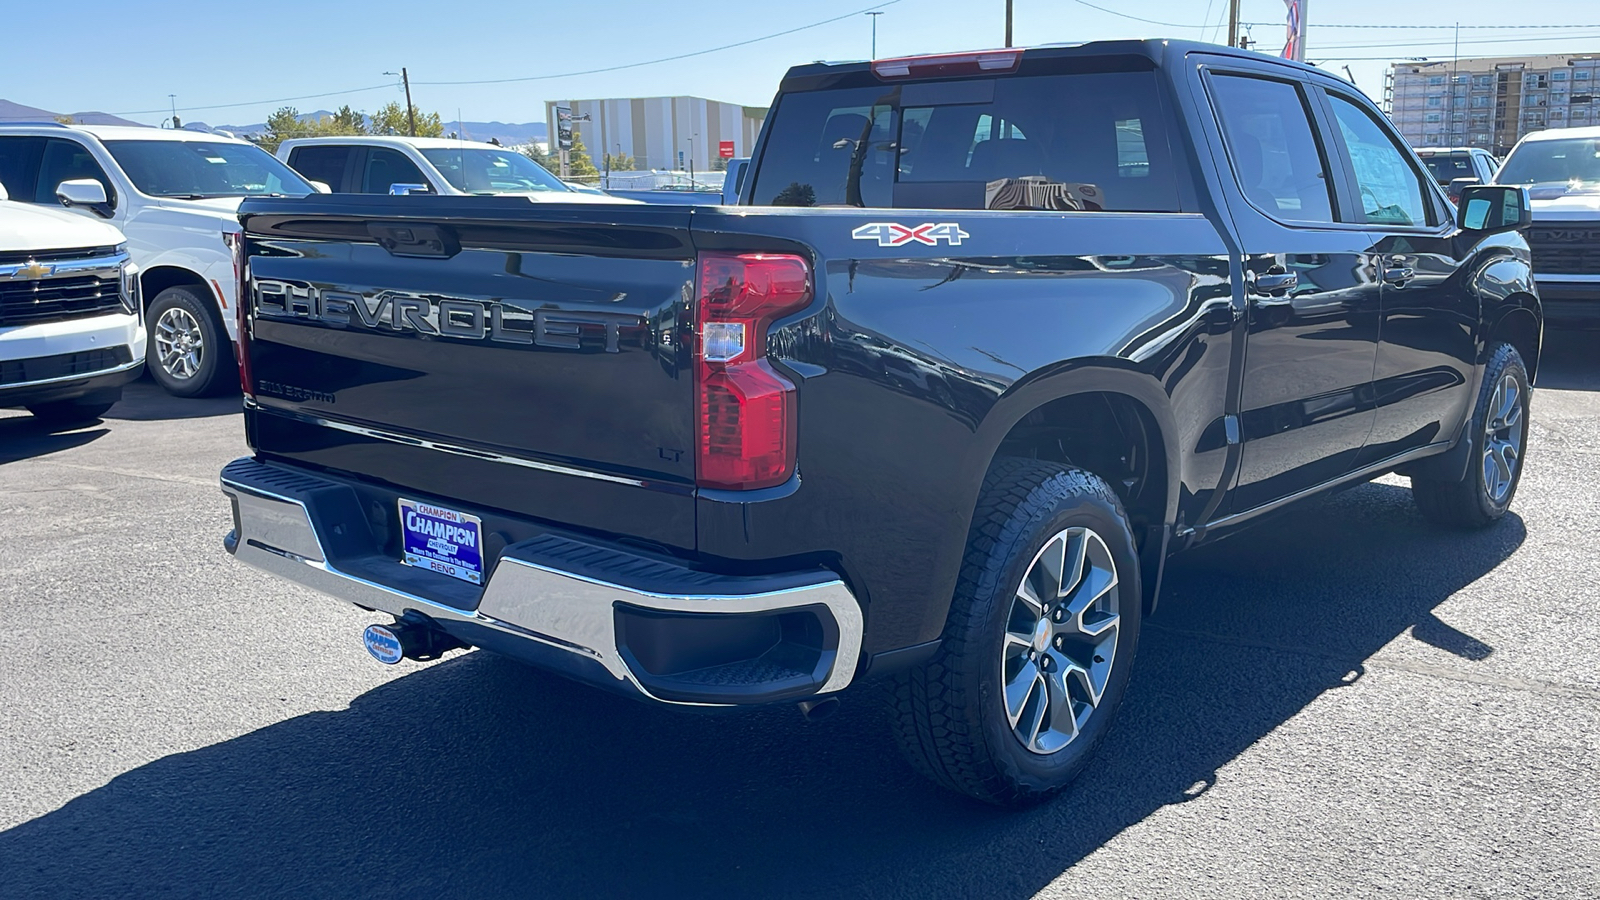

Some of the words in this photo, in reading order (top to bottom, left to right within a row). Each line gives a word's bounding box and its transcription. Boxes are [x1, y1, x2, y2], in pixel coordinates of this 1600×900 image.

[256, 282, 640, 353] CHEVROLET
[259, 380, 335, 403] SILVERADO
[657, 447, 685, 462] LT
[419, 505, 457, 520] CHAMPION
[406, 511, 475, 547] CHAMPION
[428, 540, 457, 553] CHEVROLET
[431, 561, 455, 575] RENO
